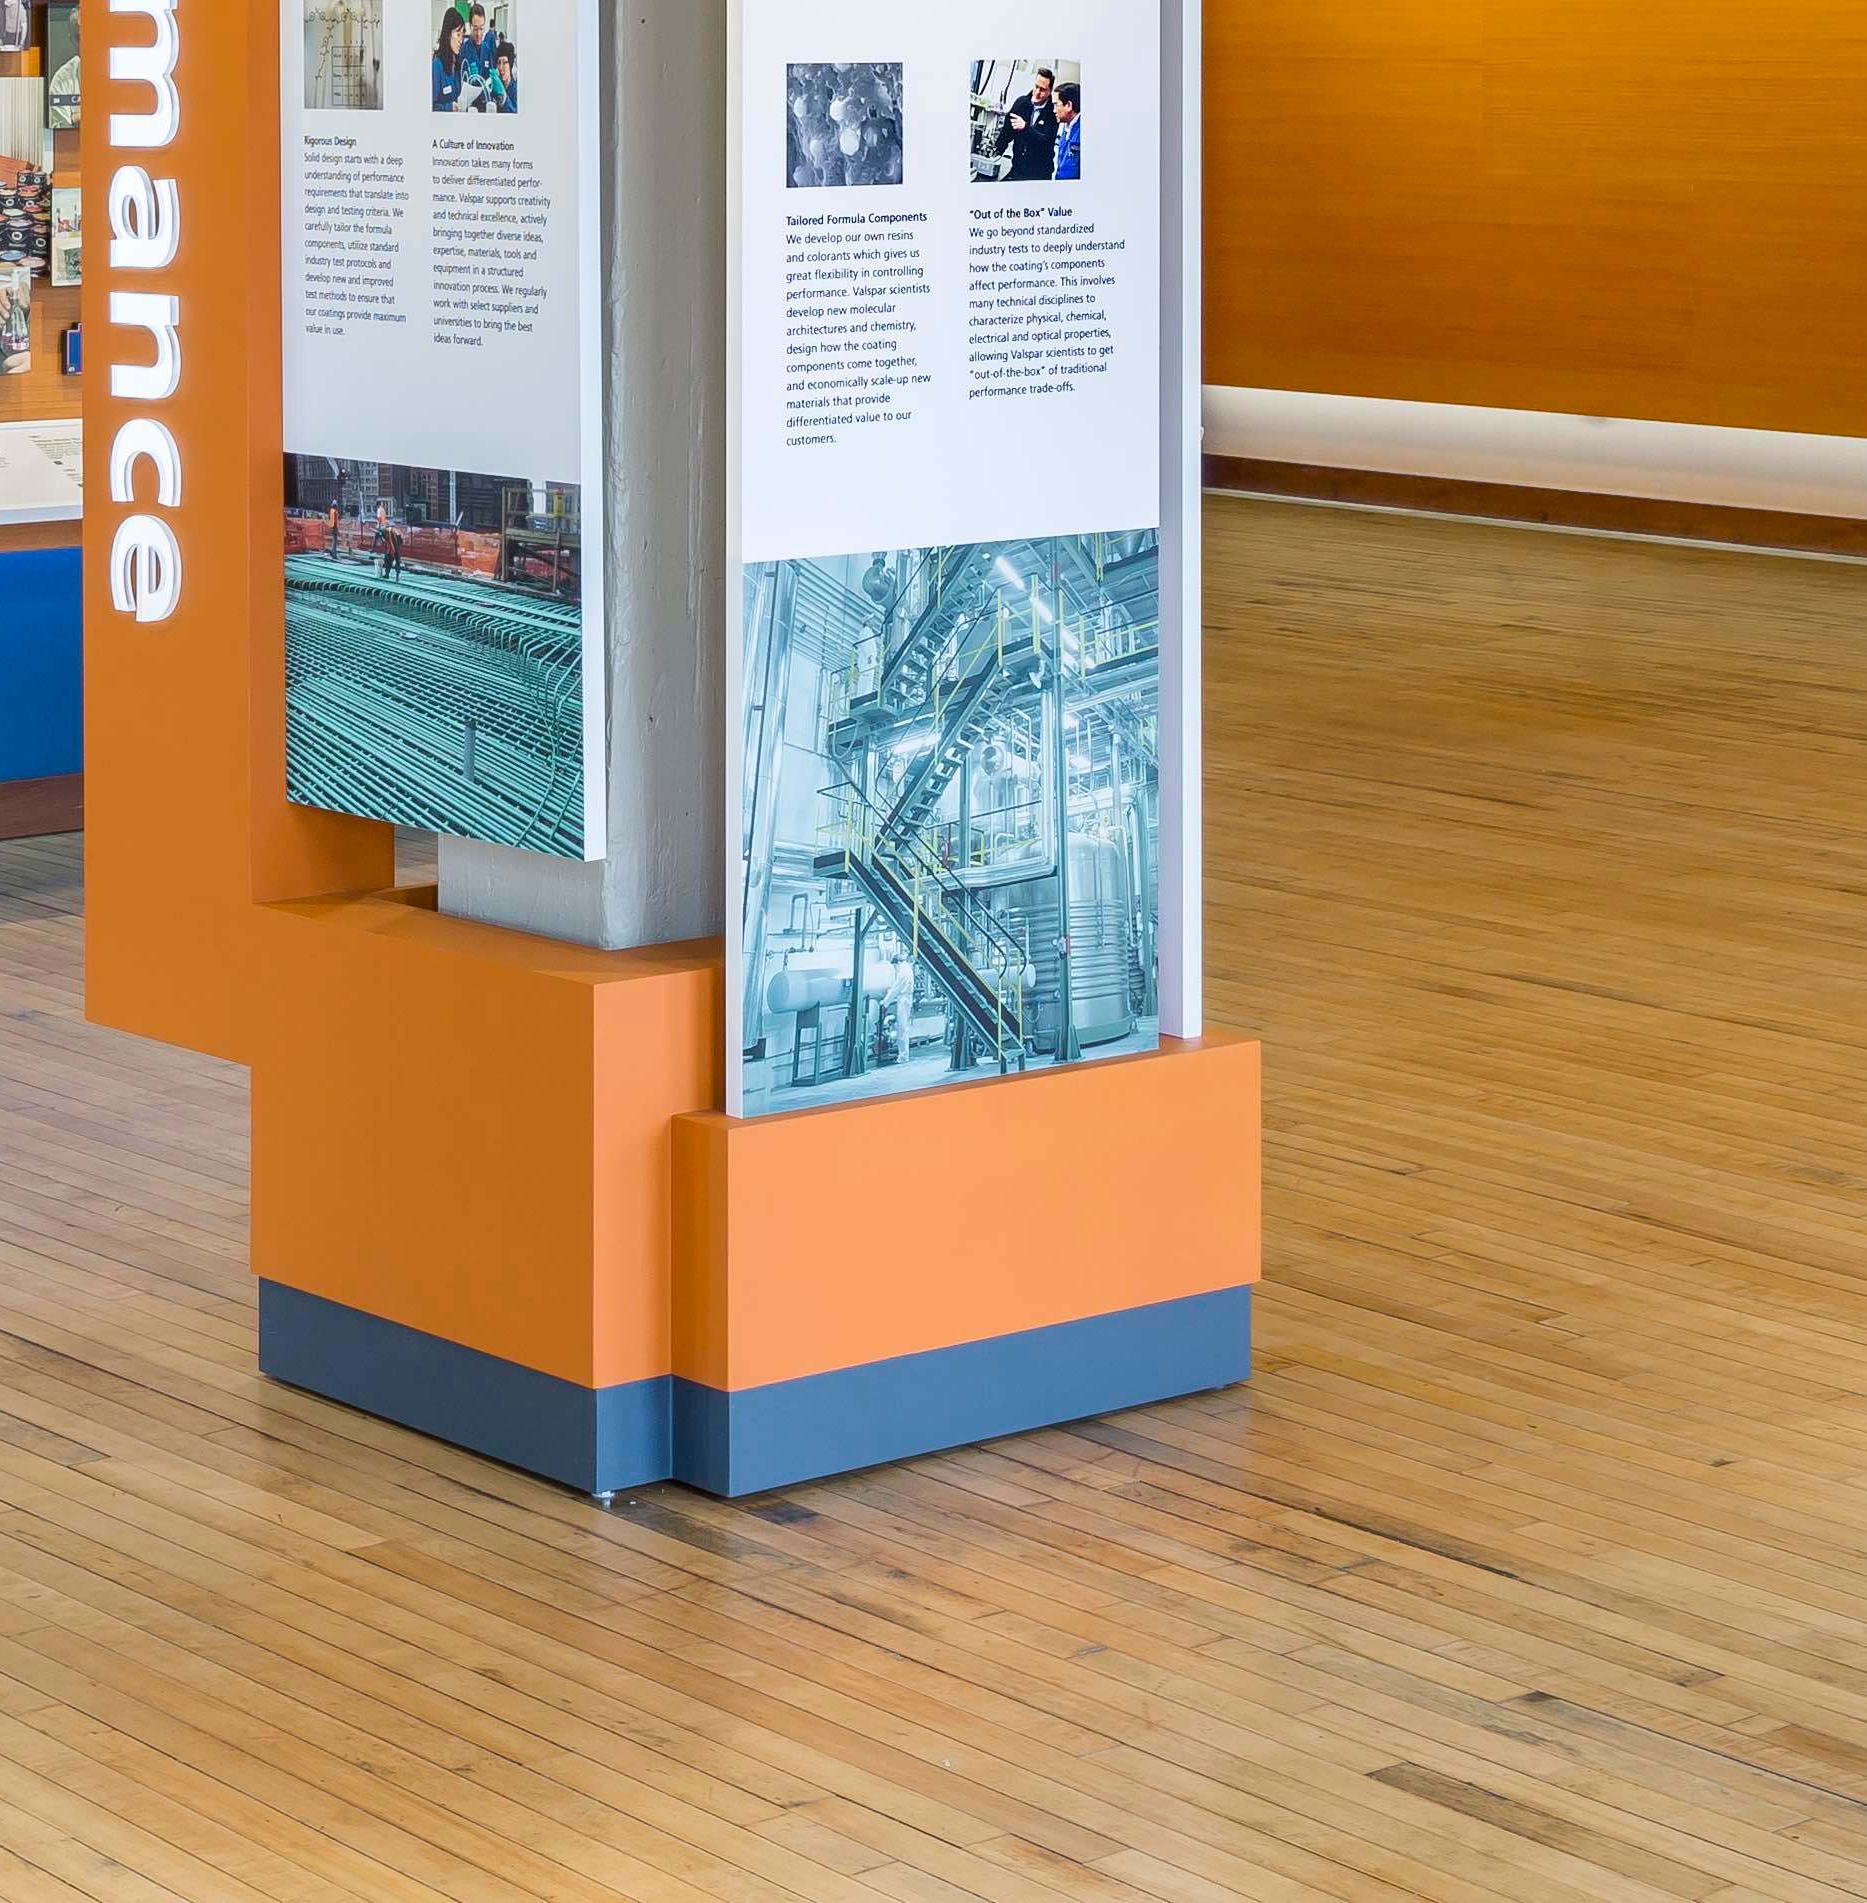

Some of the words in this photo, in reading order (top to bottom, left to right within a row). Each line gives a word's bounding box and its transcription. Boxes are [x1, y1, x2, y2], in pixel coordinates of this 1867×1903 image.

[785, 213, 824, 227] Tailored
[826, 212, 866, 225] Formula
[868, 212, 928, 225] Components
[969, 209, 992, 220] "Out
[993, 207, 1004, 219] of
[1005, 207, 1022, 219] the
[1023, 207, 1046, 218] Box"
[1047, 205, 1073, 217] Value
